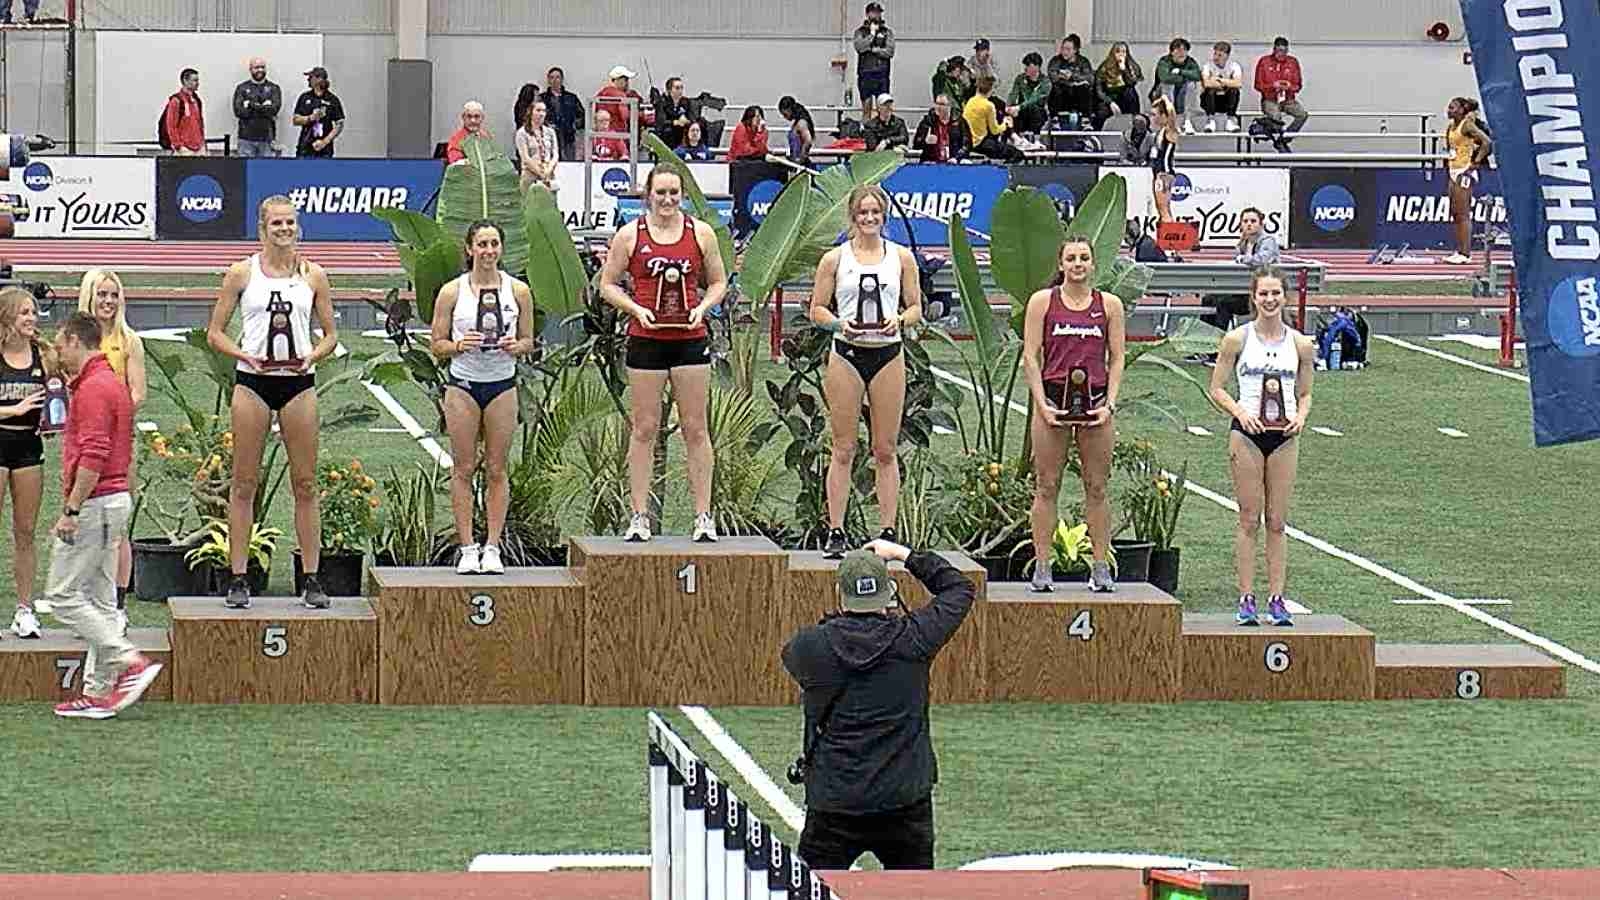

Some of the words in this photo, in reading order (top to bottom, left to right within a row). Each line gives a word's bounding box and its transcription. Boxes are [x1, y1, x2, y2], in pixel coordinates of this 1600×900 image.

[25, 175, 52, 186] NCAA
[603, 180, 631, 191] NCAA
[34, 206, 56, 223] IT
[58, 191, 147, 233] YOURS
[180, 197, 222, 211] NCAA
[288, 187, 408, 214] #NCAAD2
[1314, 207, 1354, 221] NCAA
[1196, 202, 1282, 242] YOUS
[676, 560, 698, 594] 1
[469, 594, 496, 627] 3
[1068, 609, 1095, 642] 4
[262, 627, 289, 657] 5
[1264, 641, 1292, 674] 6
[55, 657, 82, 690] 7
[1457, 669, 1482, 700] 8
